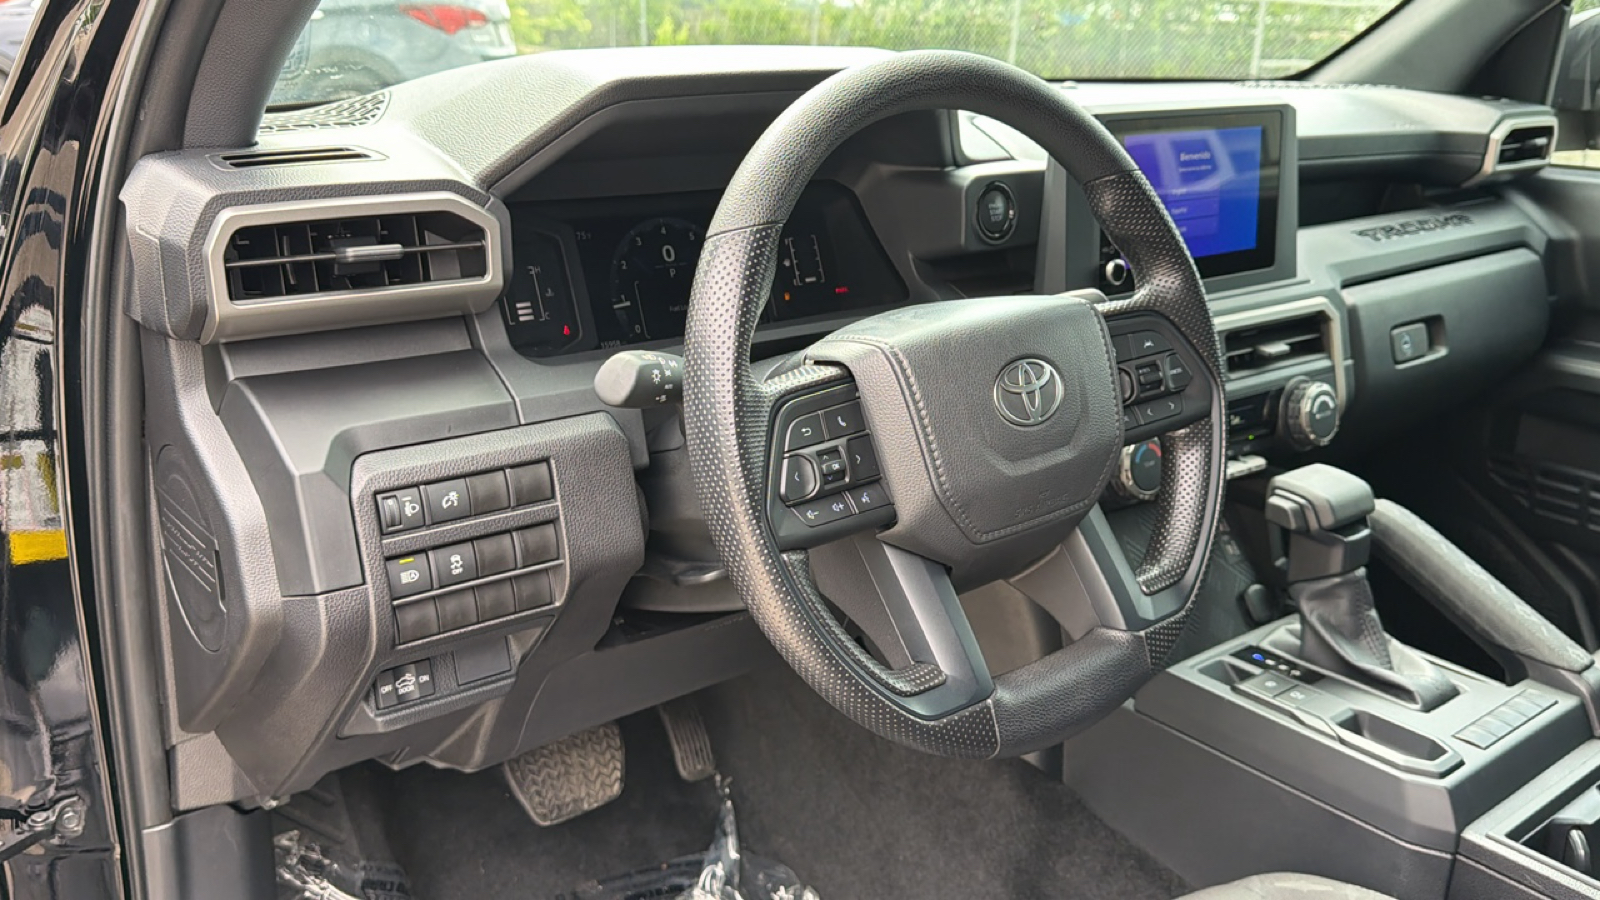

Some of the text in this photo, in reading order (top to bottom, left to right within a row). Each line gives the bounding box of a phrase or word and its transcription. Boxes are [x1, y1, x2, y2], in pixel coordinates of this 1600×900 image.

[661, 226, 666, 235] 4
[635, 236, 642, 246] 3
[662, 245, 675, 262] 0
[620, 260, 627, 270] 2
[669, 268, 676, 278] P
[634, 324, 641, 334] 0
[451, 567, 463, 575] OFF
[418, 674, 430, 683] ON
[380, 684, 393, 694] OFF
